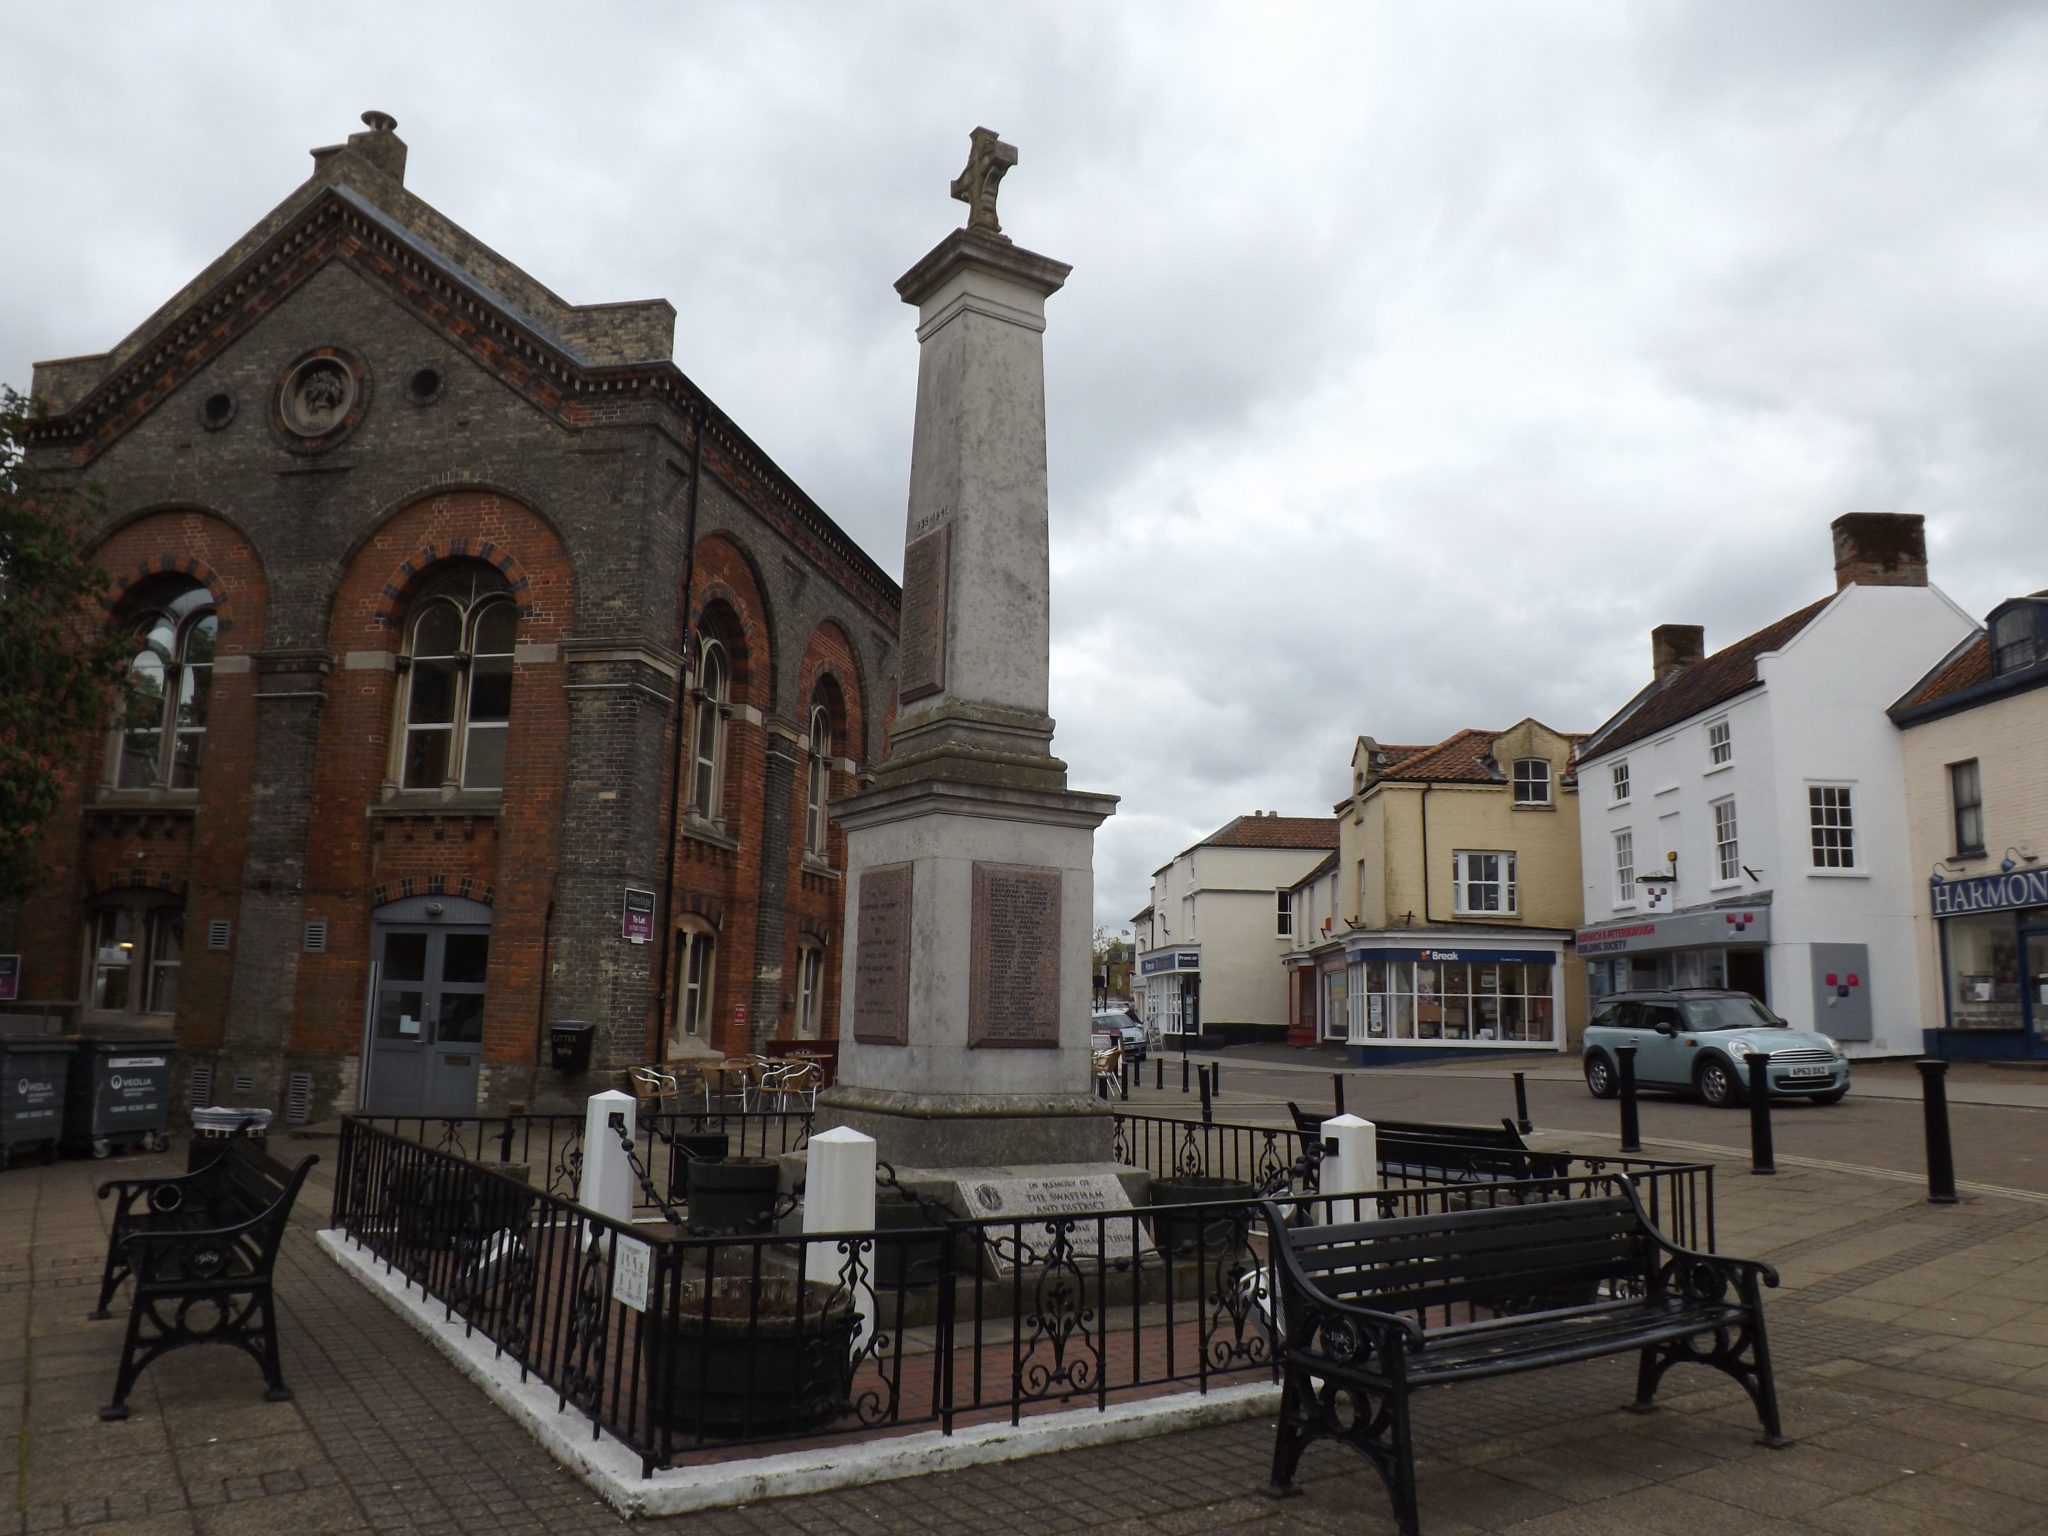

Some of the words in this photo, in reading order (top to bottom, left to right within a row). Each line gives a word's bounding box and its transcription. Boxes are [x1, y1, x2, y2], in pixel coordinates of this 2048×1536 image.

[1577, 930, 1602, 943] NORWICH
[1607, 924, 1655, 938] PETERBOROUGH
[1578, 942, 1602, 954] BUILDING
[1603, 939, 1627, 949] SOCIETY
[1432, 951, 1458, 961] Break
[553, 1034, 577, 1043] LITTER
[123, 1078, 152, 1087] VEOLIA
[203, 1129, 265, 1139] LITER
[1042, 1180, 1076, 1189] MEMORY
[1080, 1179, 1091, 1187] OF
[1027, 1194, 1046, 1203] THE
[1050, 1191, 1105, 1201] SWAFFHAM
[1037, 1204, 1059, 1214] AND
[1062, 1202, 1105, 1212] DISTRICT
[1108, 1235, 1131, 1243] THEM
